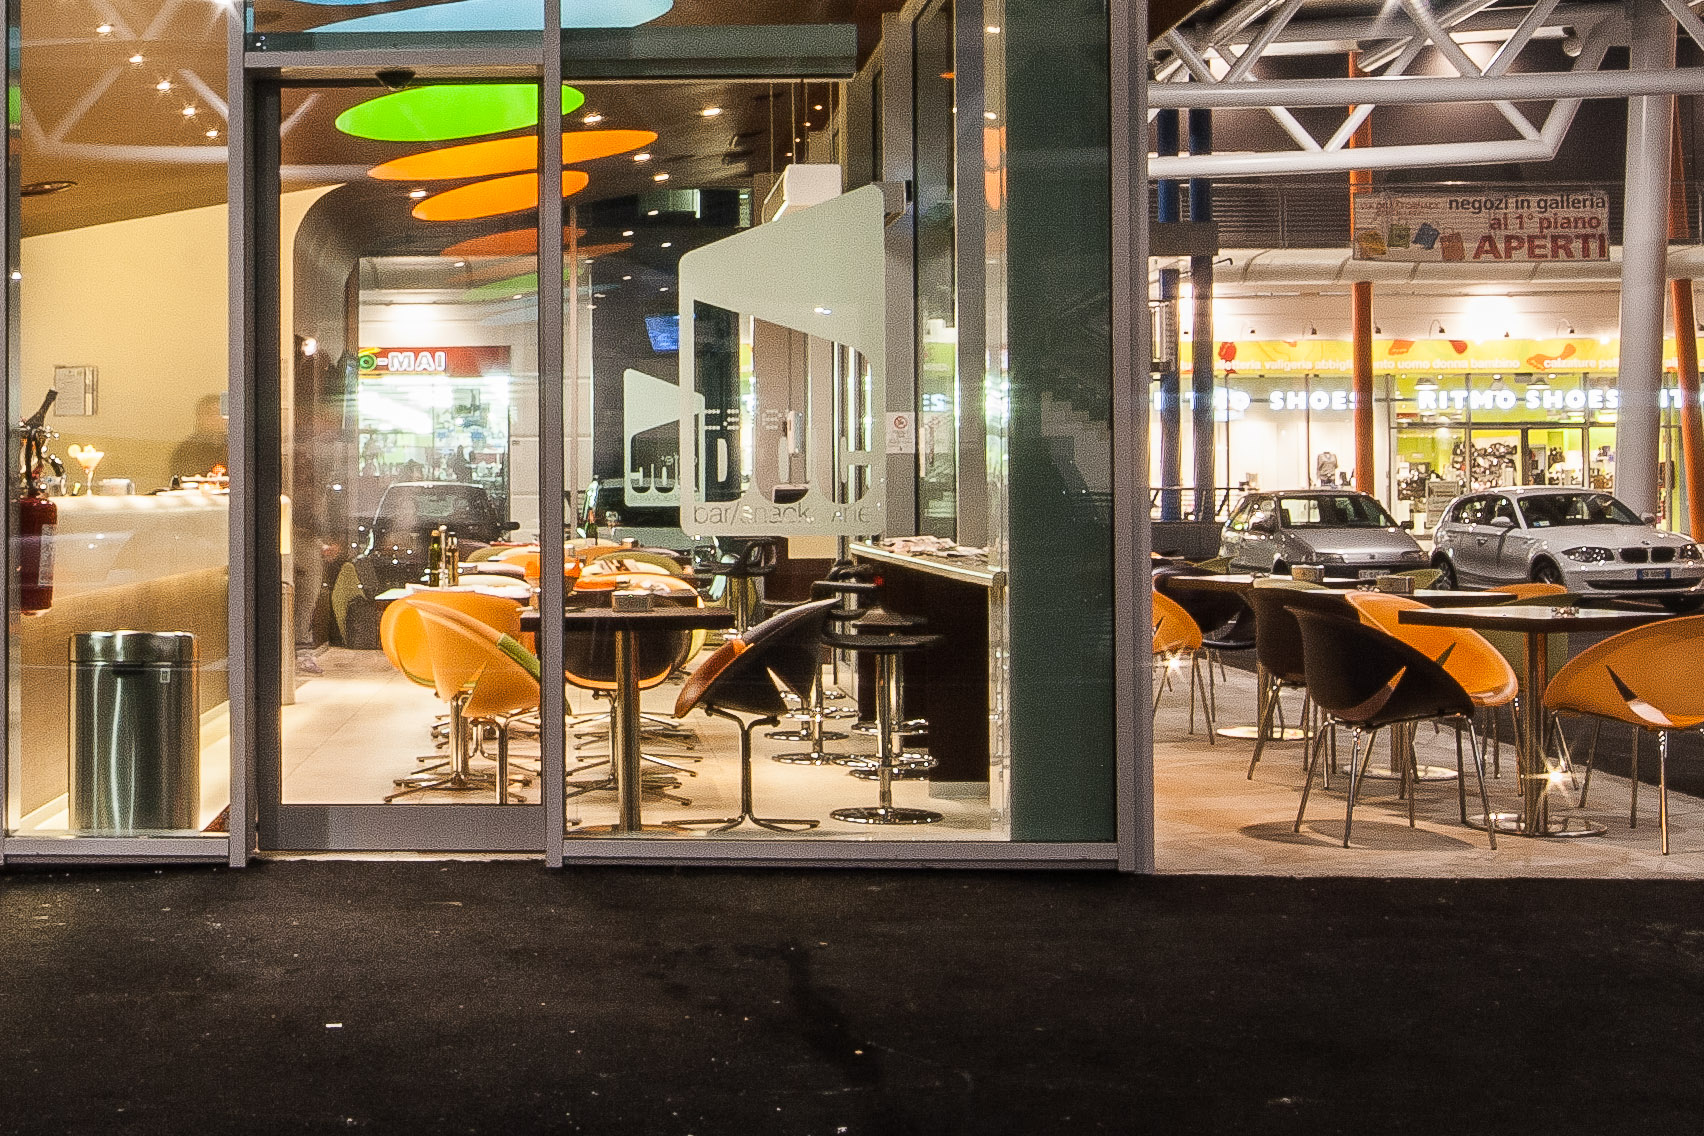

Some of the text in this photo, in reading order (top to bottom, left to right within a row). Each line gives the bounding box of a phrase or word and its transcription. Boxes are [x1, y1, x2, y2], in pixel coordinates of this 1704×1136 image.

[1448, 194, 1508, 214] negozi
[1514, 194, 1531, 210] in
[1536, 192, 1606, 214] galleria
[1538, 212, 1602, 234] piano
[1472, 232, 1606, 261] APERTI
[1418, 388, 1619, 410] RITMO SHOES
